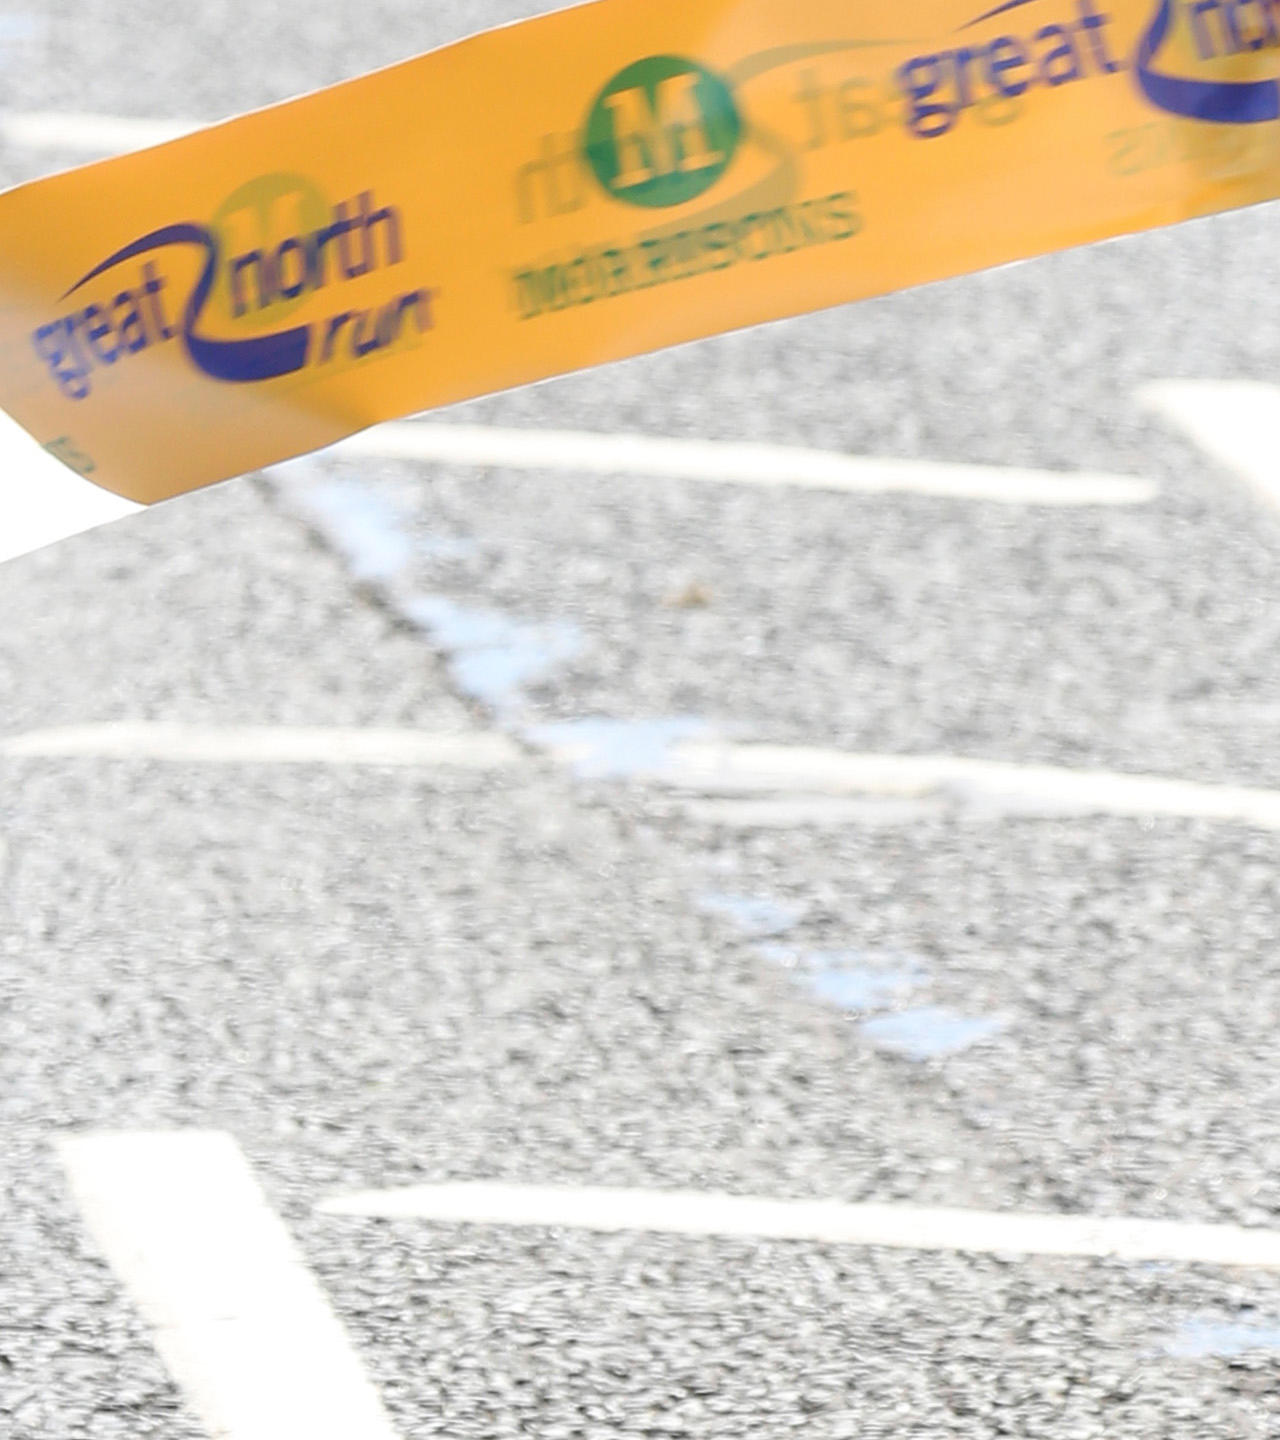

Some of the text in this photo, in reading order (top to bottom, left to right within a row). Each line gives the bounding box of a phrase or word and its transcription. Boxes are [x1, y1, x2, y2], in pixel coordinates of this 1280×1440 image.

[33, 189, 406, 399] great north
[318, 288, 436, 365] run
